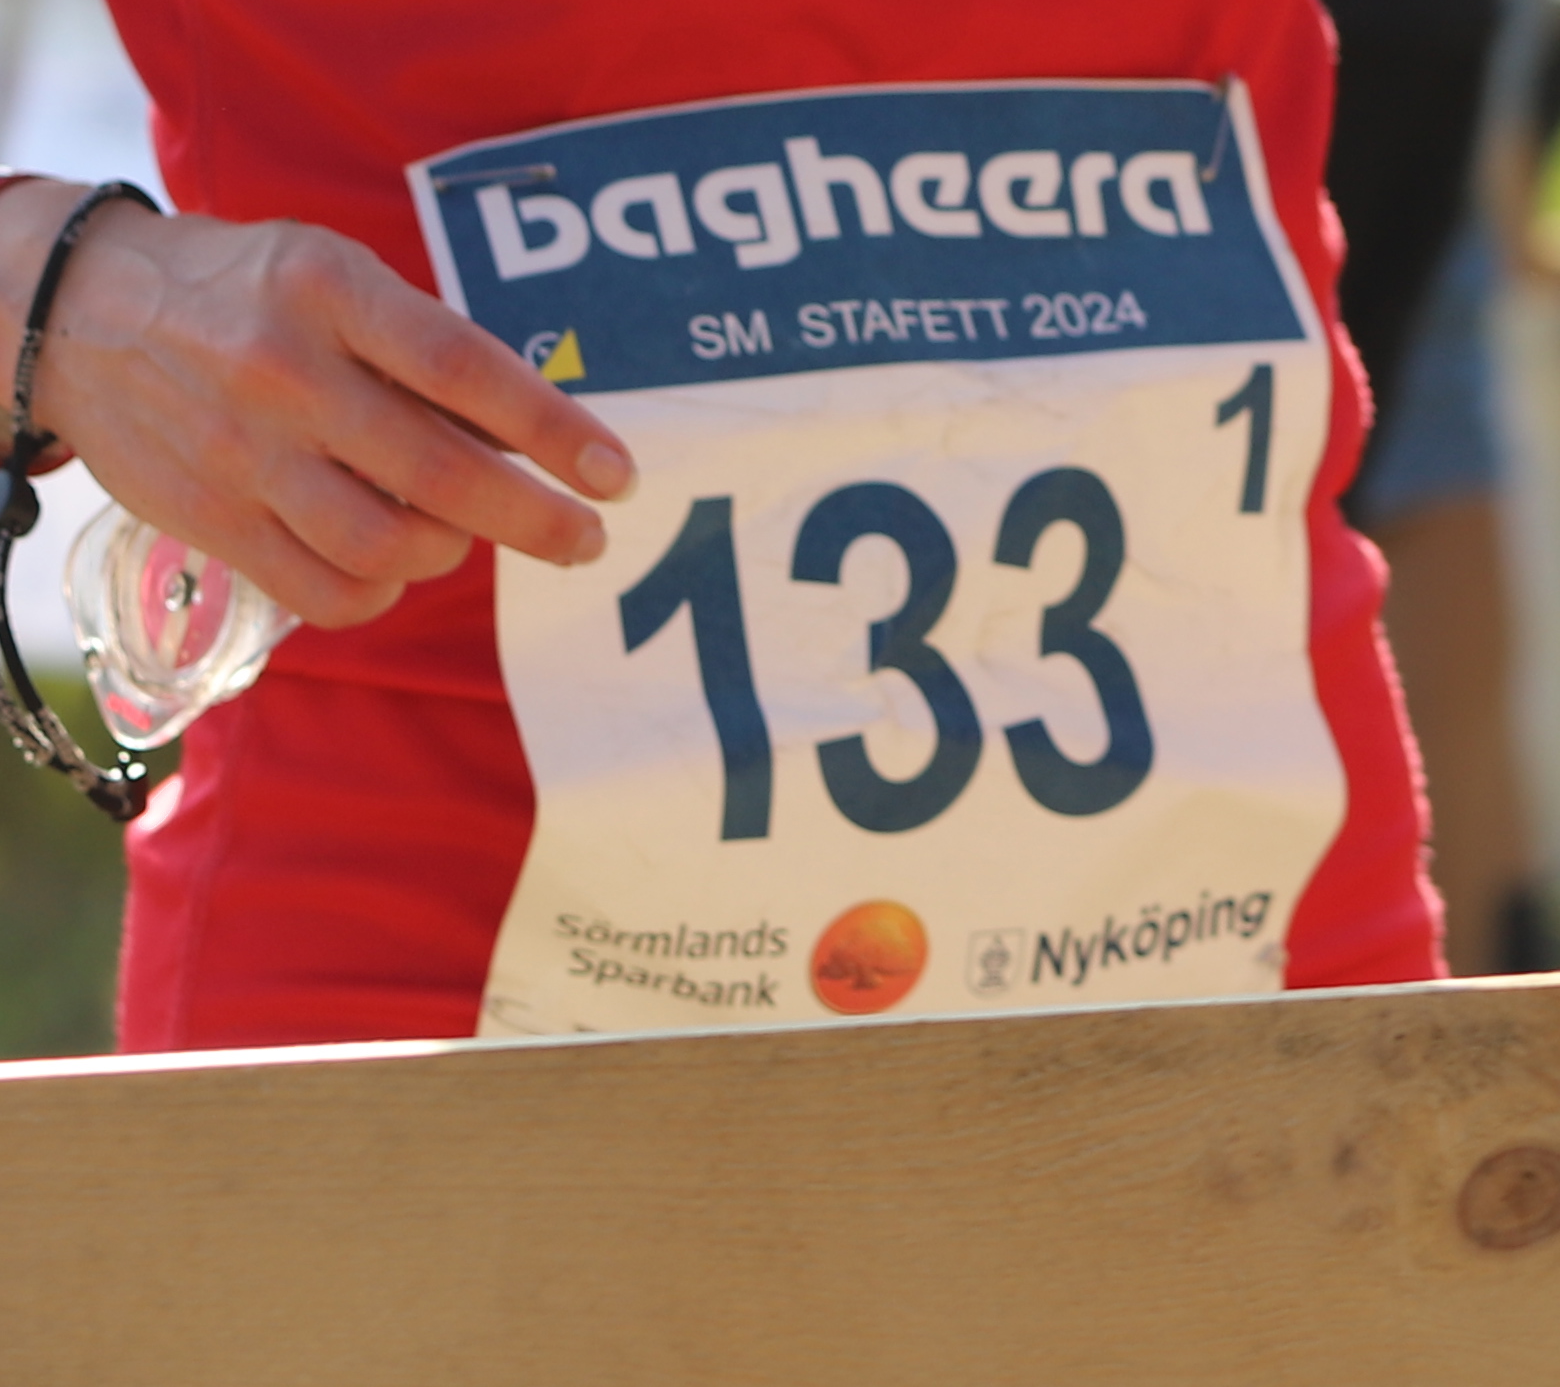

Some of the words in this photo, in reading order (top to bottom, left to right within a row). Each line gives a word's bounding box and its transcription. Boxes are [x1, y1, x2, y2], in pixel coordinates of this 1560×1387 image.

[475, 136, 1212, 281] bagheera
[688, 309, 774, 360] SM
[798, 299, 1010, 349] STAFETT
[1022, 291, 1146, 339] 2024
[1215, 362, 1274, 514] 1
[617, 465, 1154, 841] 133
[554, 913, 788, 958] Sörmlands
[568, 947, 779, 1007] Sparbank
[1031, 890, 1273, 986] Nyköping
